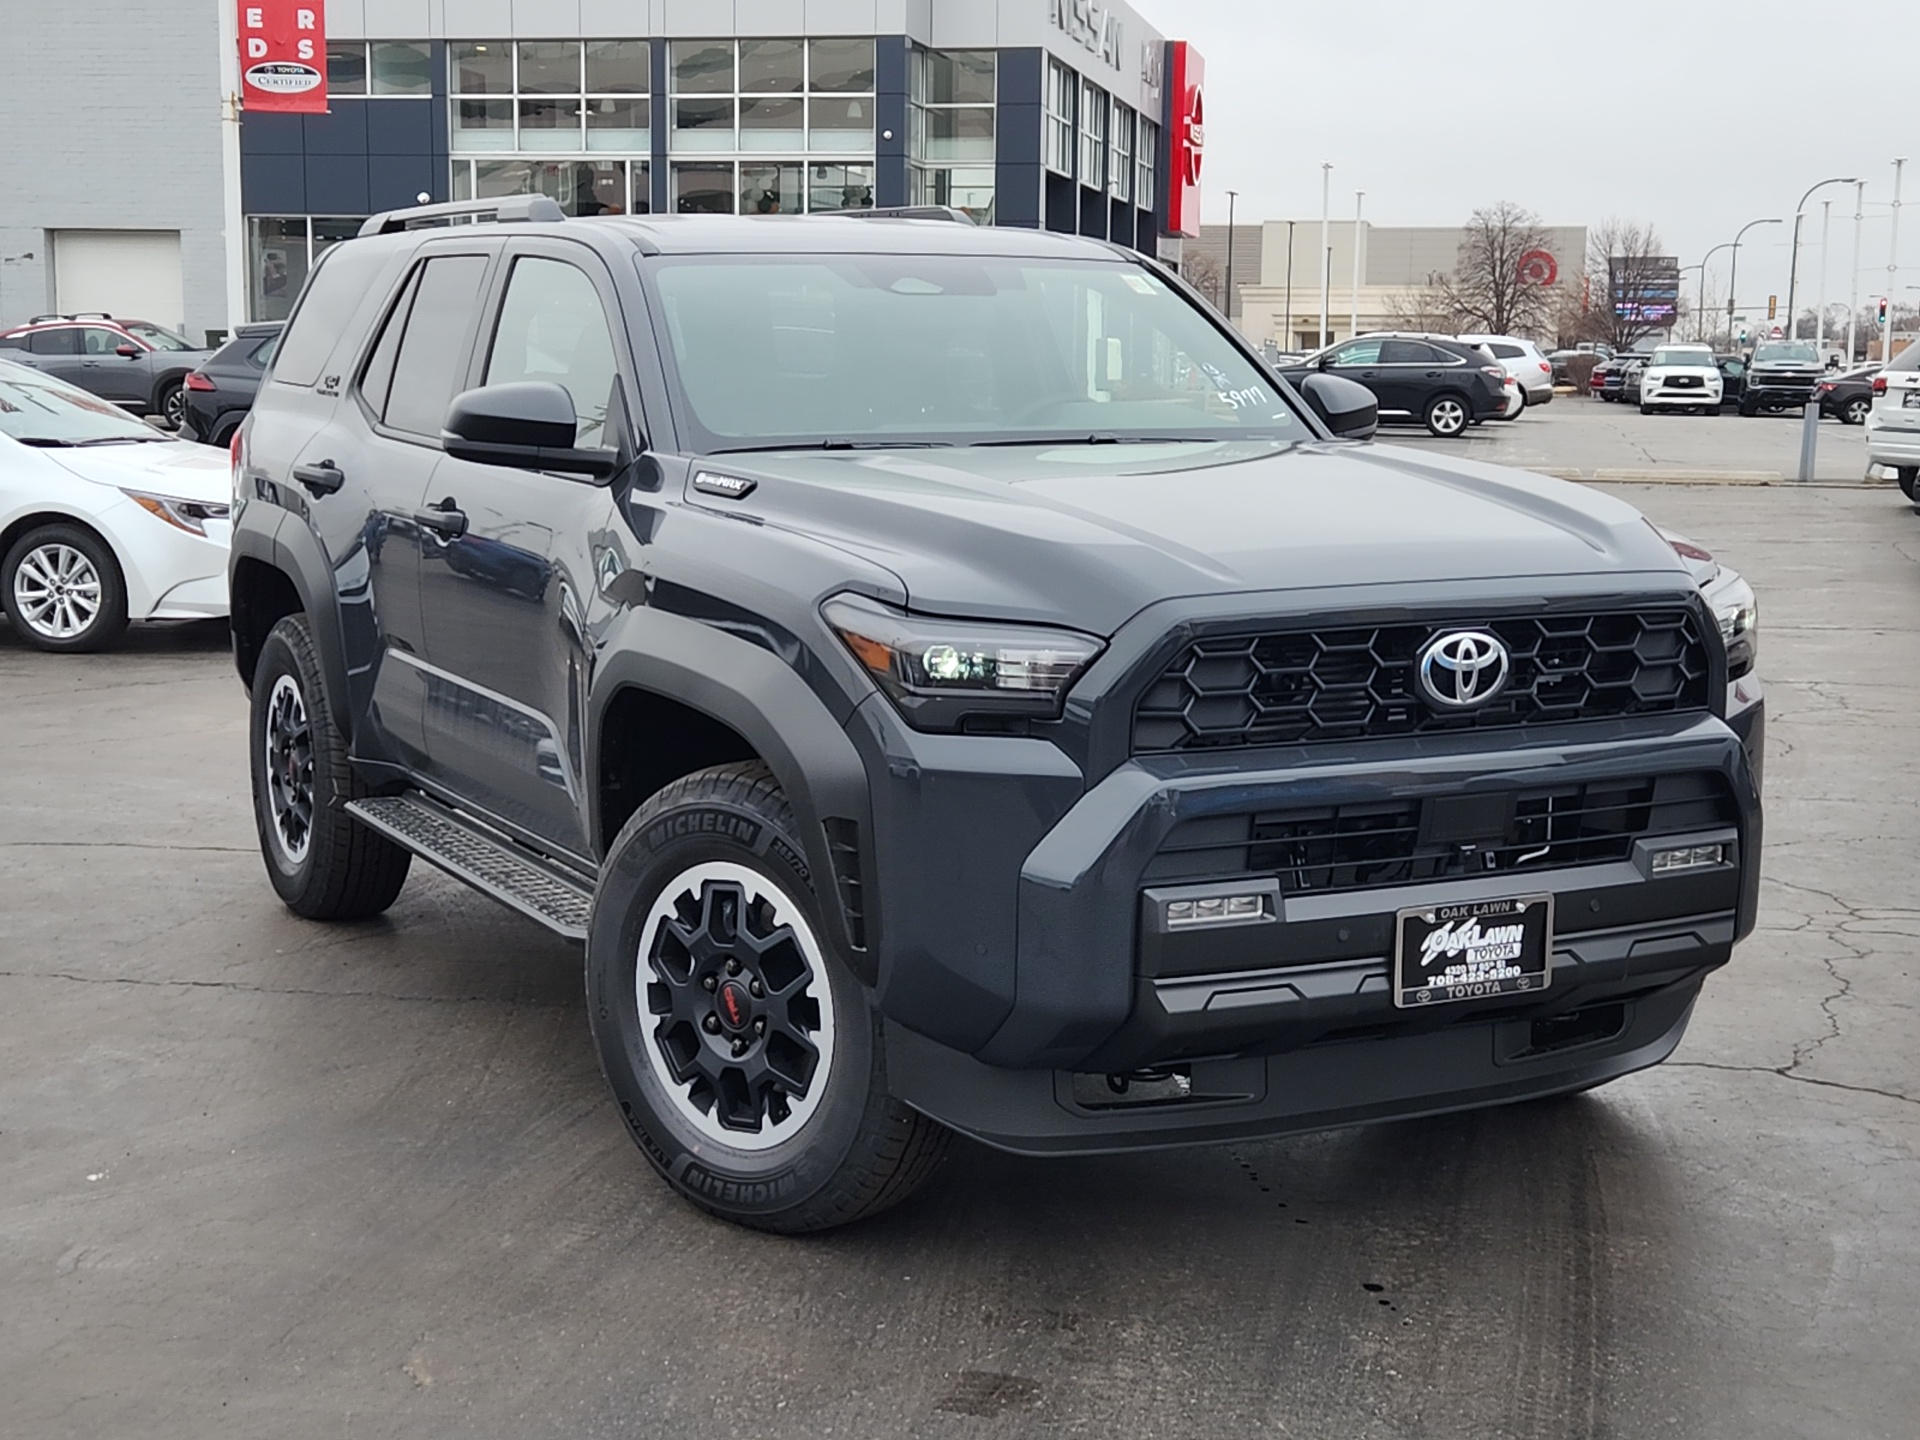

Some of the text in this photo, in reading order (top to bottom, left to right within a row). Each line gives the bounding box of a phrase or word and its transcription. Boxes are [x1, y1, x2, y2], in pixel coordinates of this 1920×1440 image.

[246, 8, 315, 29] E R
[248, 38, 314, 60] D S
[258, 76, 311, 86] CERTIFIED
[650, 813, 754, 848] MICHELIN
[1440, 901, 1511, 919] OAK LAWN
[1474, 945, 1515, 959] TOYOTA
[1446, 981, 1501, 998] TOYOTA
[685, 1166, 797, 1201] MICHELIN
